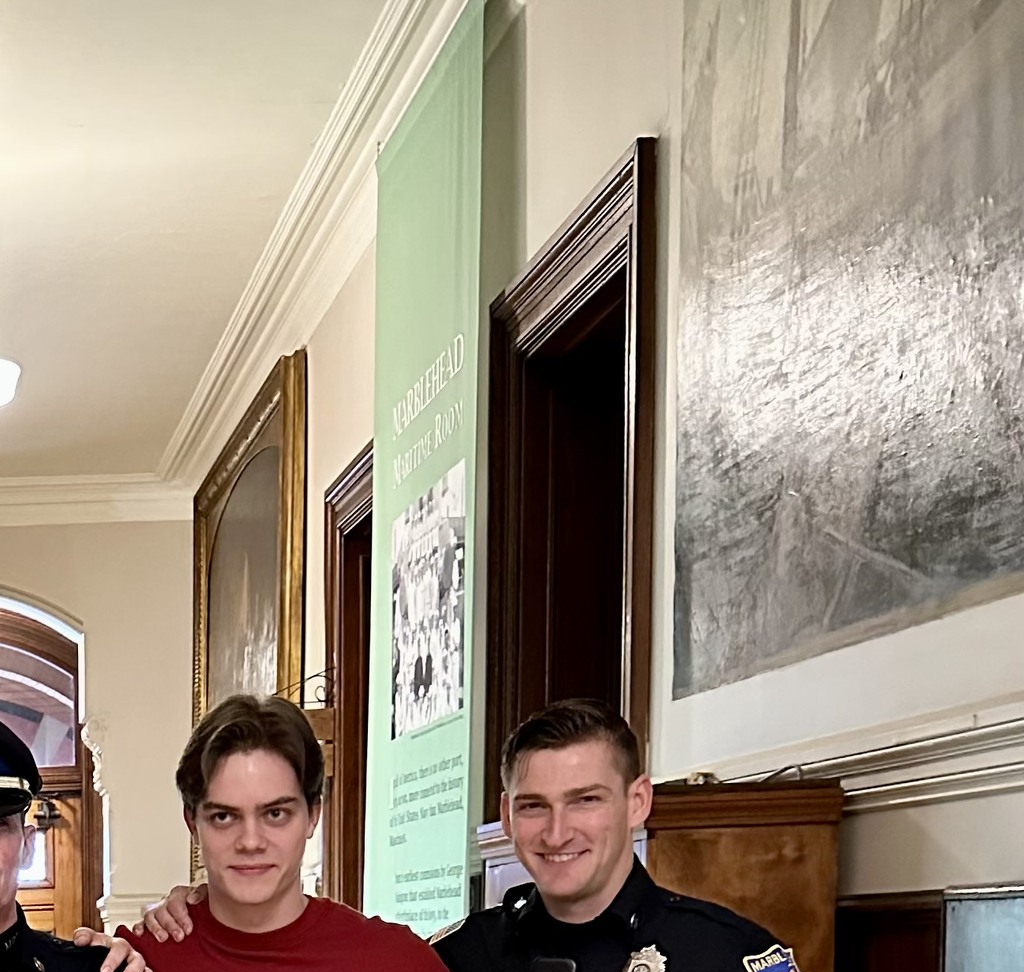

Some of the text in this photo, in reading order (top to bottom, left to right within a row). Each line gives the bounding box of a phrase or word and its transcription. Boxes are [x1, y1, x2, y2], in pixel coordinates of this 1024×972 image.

[392, 333, 465, 441] MARBLEHEAD
[392, 398, 464, 490] MARITIME ROOM
